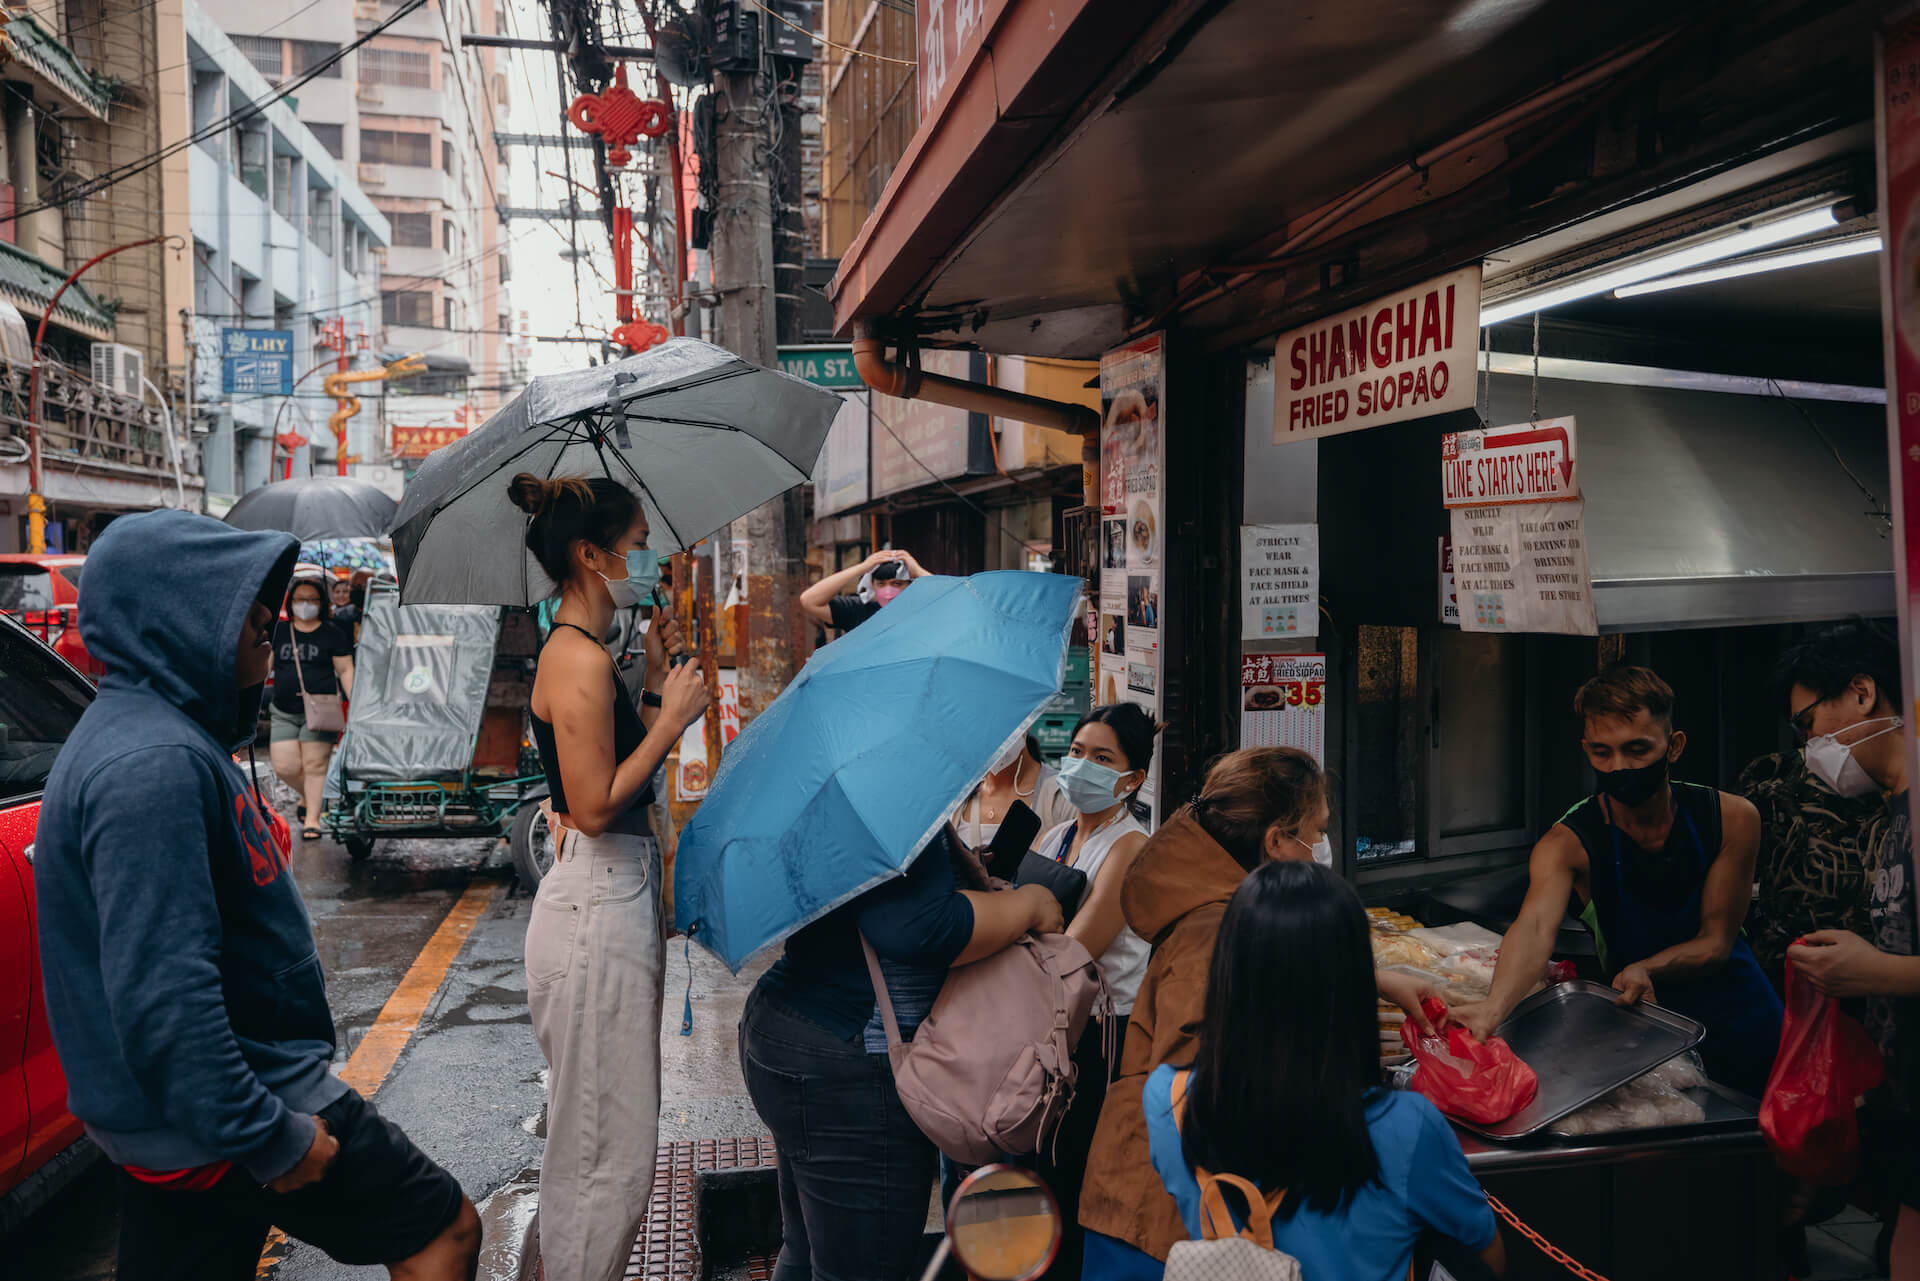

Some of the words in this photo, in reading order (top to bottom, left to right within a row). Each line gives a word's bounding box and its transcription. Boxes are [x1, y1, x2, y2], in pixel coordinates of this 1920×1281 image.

[1290, 284, 1455, 391] SHANGHAI
[251, 338, 287, 352] LHY
[824, 358, 852, 378] ST.
[1290, 389, 1348, 431] FRIED
[1356, 361, 1449, 416] SIOPAO
[1446, 460, 1473, 498] LINE
[1477, 454, 1524, 496] STARTS
[1527, 450, 1557, 492] HERE
[1464, 508, 1502, 519] STRICTLY
[1472, 526, 1494, 536] WEAR
[1520, 523, 1539, 533] TAKE
[1539, 521, 1555, 533] OUT
[1256, 537, 1300, 547] STRICTLY
[1534, 539, 1566, 550] EATING
[1265, 551, 1292, 560] WEAR
[1459, 545, 1480, 556] FACE
[1481, 544, 1501, 555] MASK
[1503, 545, 1509, 554] &
[1249, 567, 1271, 576] FACE
[1273, 566, 1300, 575] MASK
[1302, 566, 1309, 575] &
[1461, 563, 1480, 573] FACE
[1483, 561, 1511, 573] SHIELD
[1461, 580, 1473, 590] AT
[1474, 580, 1489, 590] ALL
[1490, 579, 1515, 590] TIMES
[1536, 574, 1569, 584] INFRONT
[1250, 582, 1272, 591] FACE
[1274, 580, 1309, 590] SHIELD
[1249, 596, 1262, 606] AT
[1263, 595, 1280, 605] ALL
[1281, 594, 1310, 604] TIMES
[1540, 591, 1556, 601] THE
[1558, 591, 1582, 601] STORE
[1296, 668, 1325, 677] SIOPAO
[1286, 681, 1323, 706] 35
